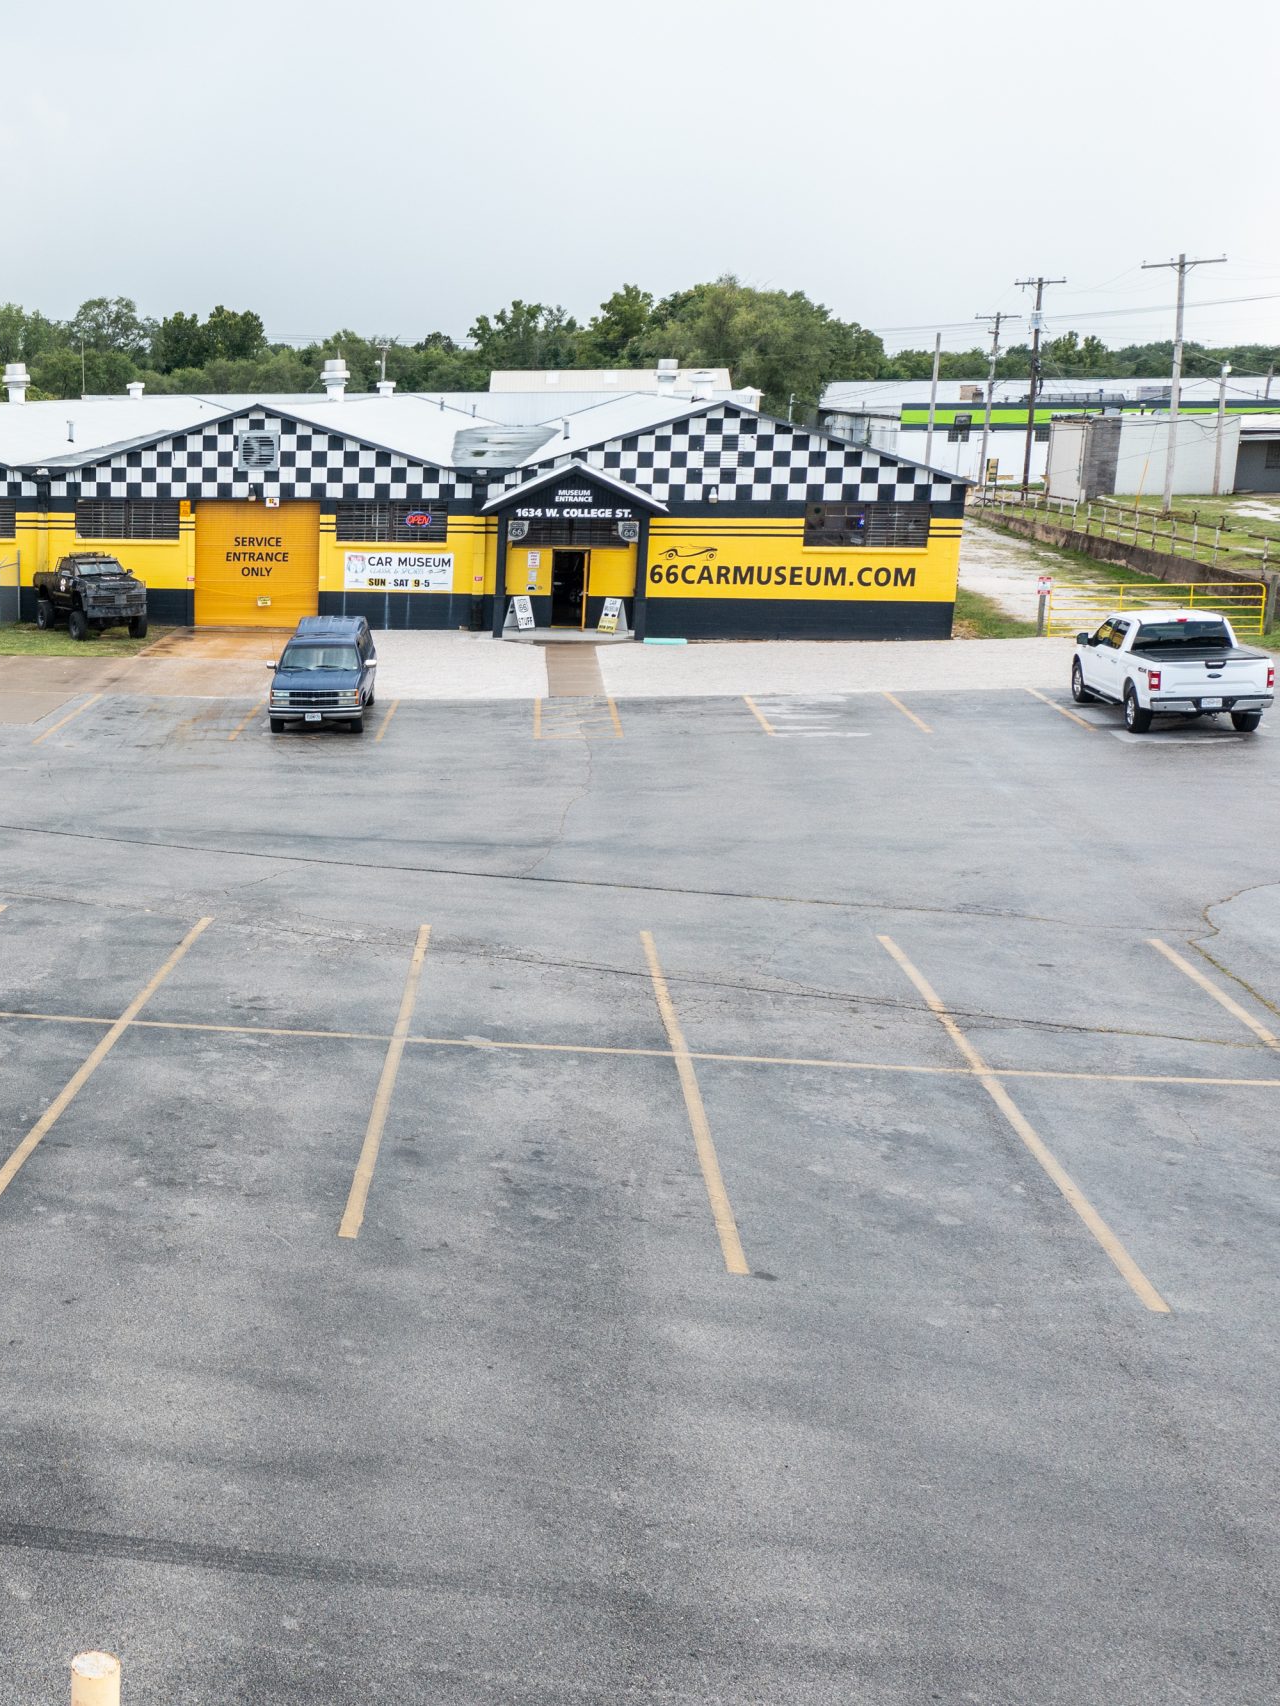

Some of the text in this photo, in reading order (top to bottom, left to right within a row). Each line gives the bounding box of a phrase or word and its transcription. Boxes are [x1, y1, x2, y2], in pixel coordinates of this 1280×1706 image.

[515, 508, 632, 518] 1634 W. COLLEGE ST.
[406, 514, 430, 525] OPEN
[512, 528, 523, 536] 66
[624, 529, 635, 537] 66
[234, 536, 282, 547] SERVICE
[225, 551, 289, 562] ENTRANCE
[367, 556, 392, 567] CAR
[398, 557, 451, 568] MUSEUM
[241, 567, 273, 577] ONLY
[649, 563, 917, 587] 66CARMUSEUM.COM
[368, 578, 386, 587] SUN
[393, 579, 410, 587] SAT
[413, 579, 430, 588] 9-5
